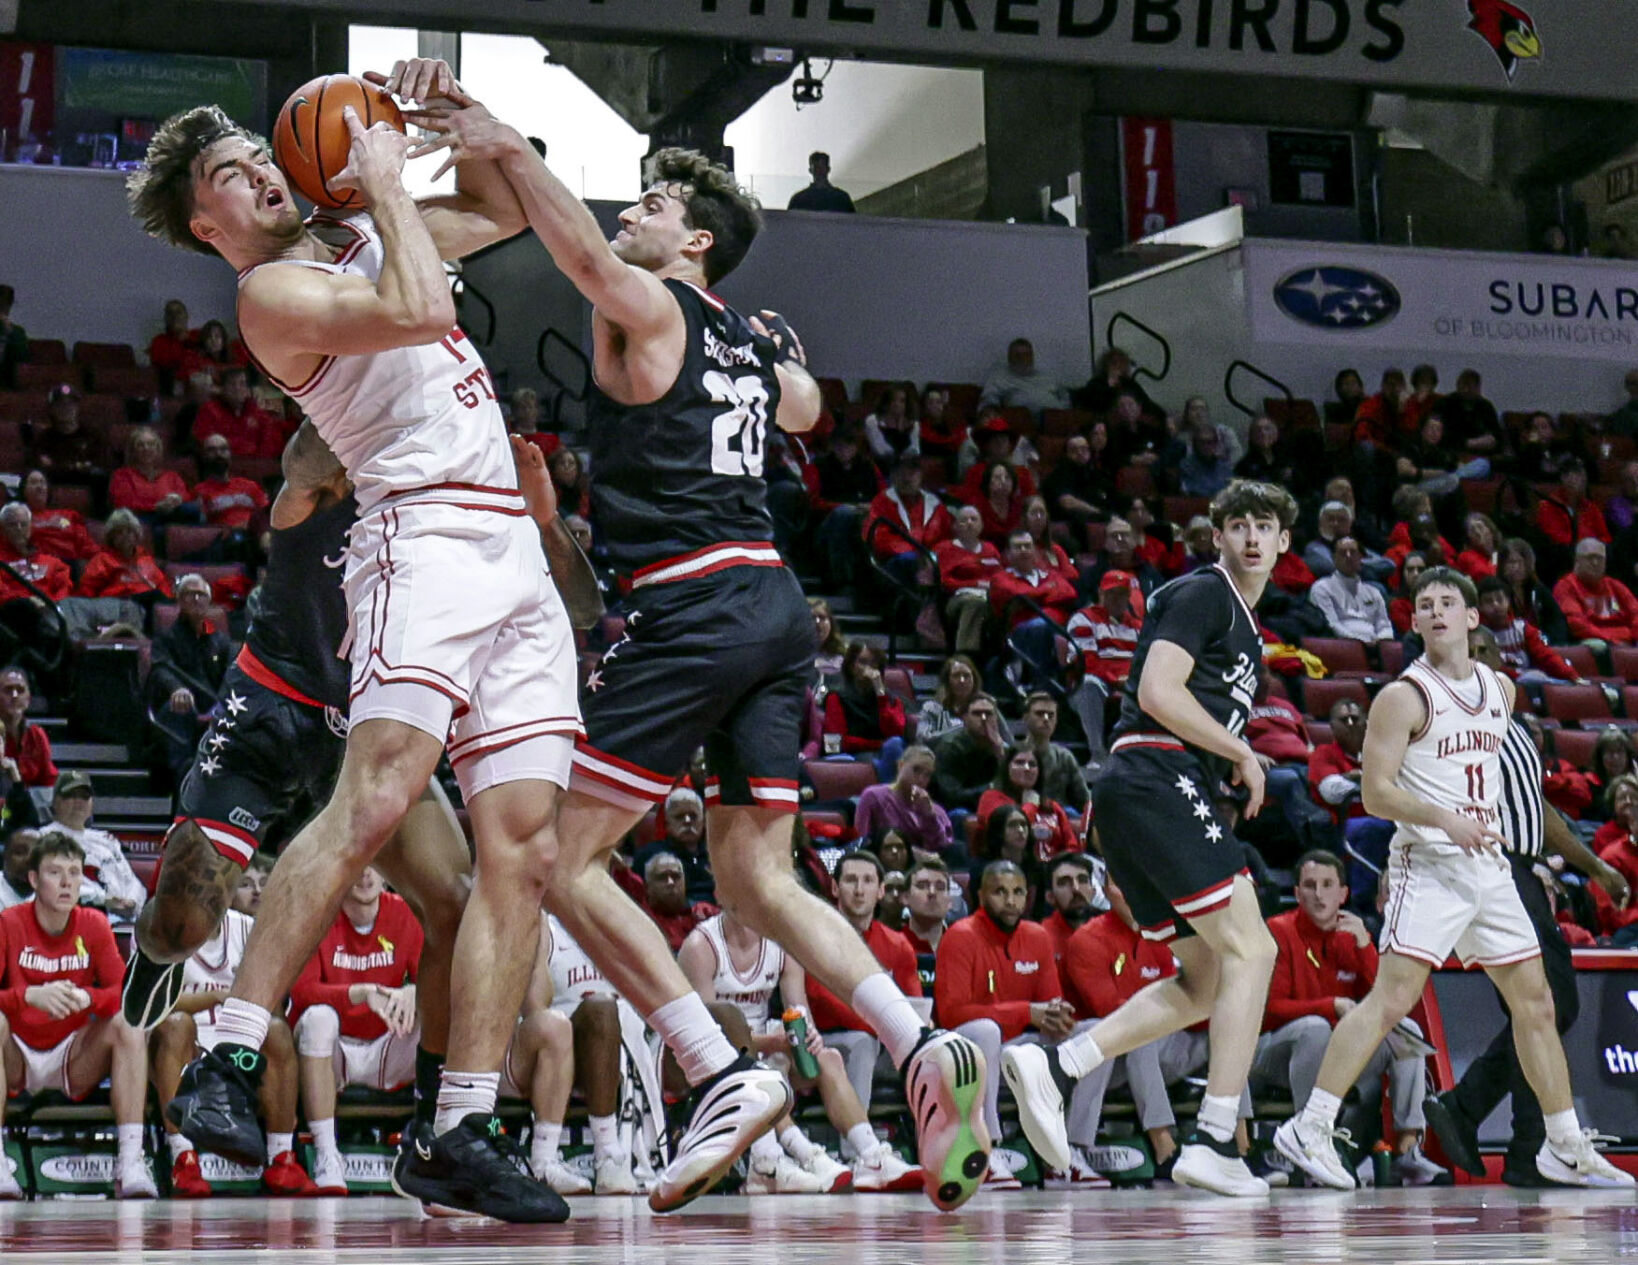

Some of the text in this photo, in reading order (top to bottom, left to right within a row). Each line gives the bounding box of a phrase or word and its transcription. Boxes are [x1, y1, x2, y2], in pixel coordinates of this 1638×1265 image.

[1434, 317, 1632, 345] OF BLOOMINGTON
[702, 370, 769, 478] 20
[1464, 763, 1485, 801] 11
